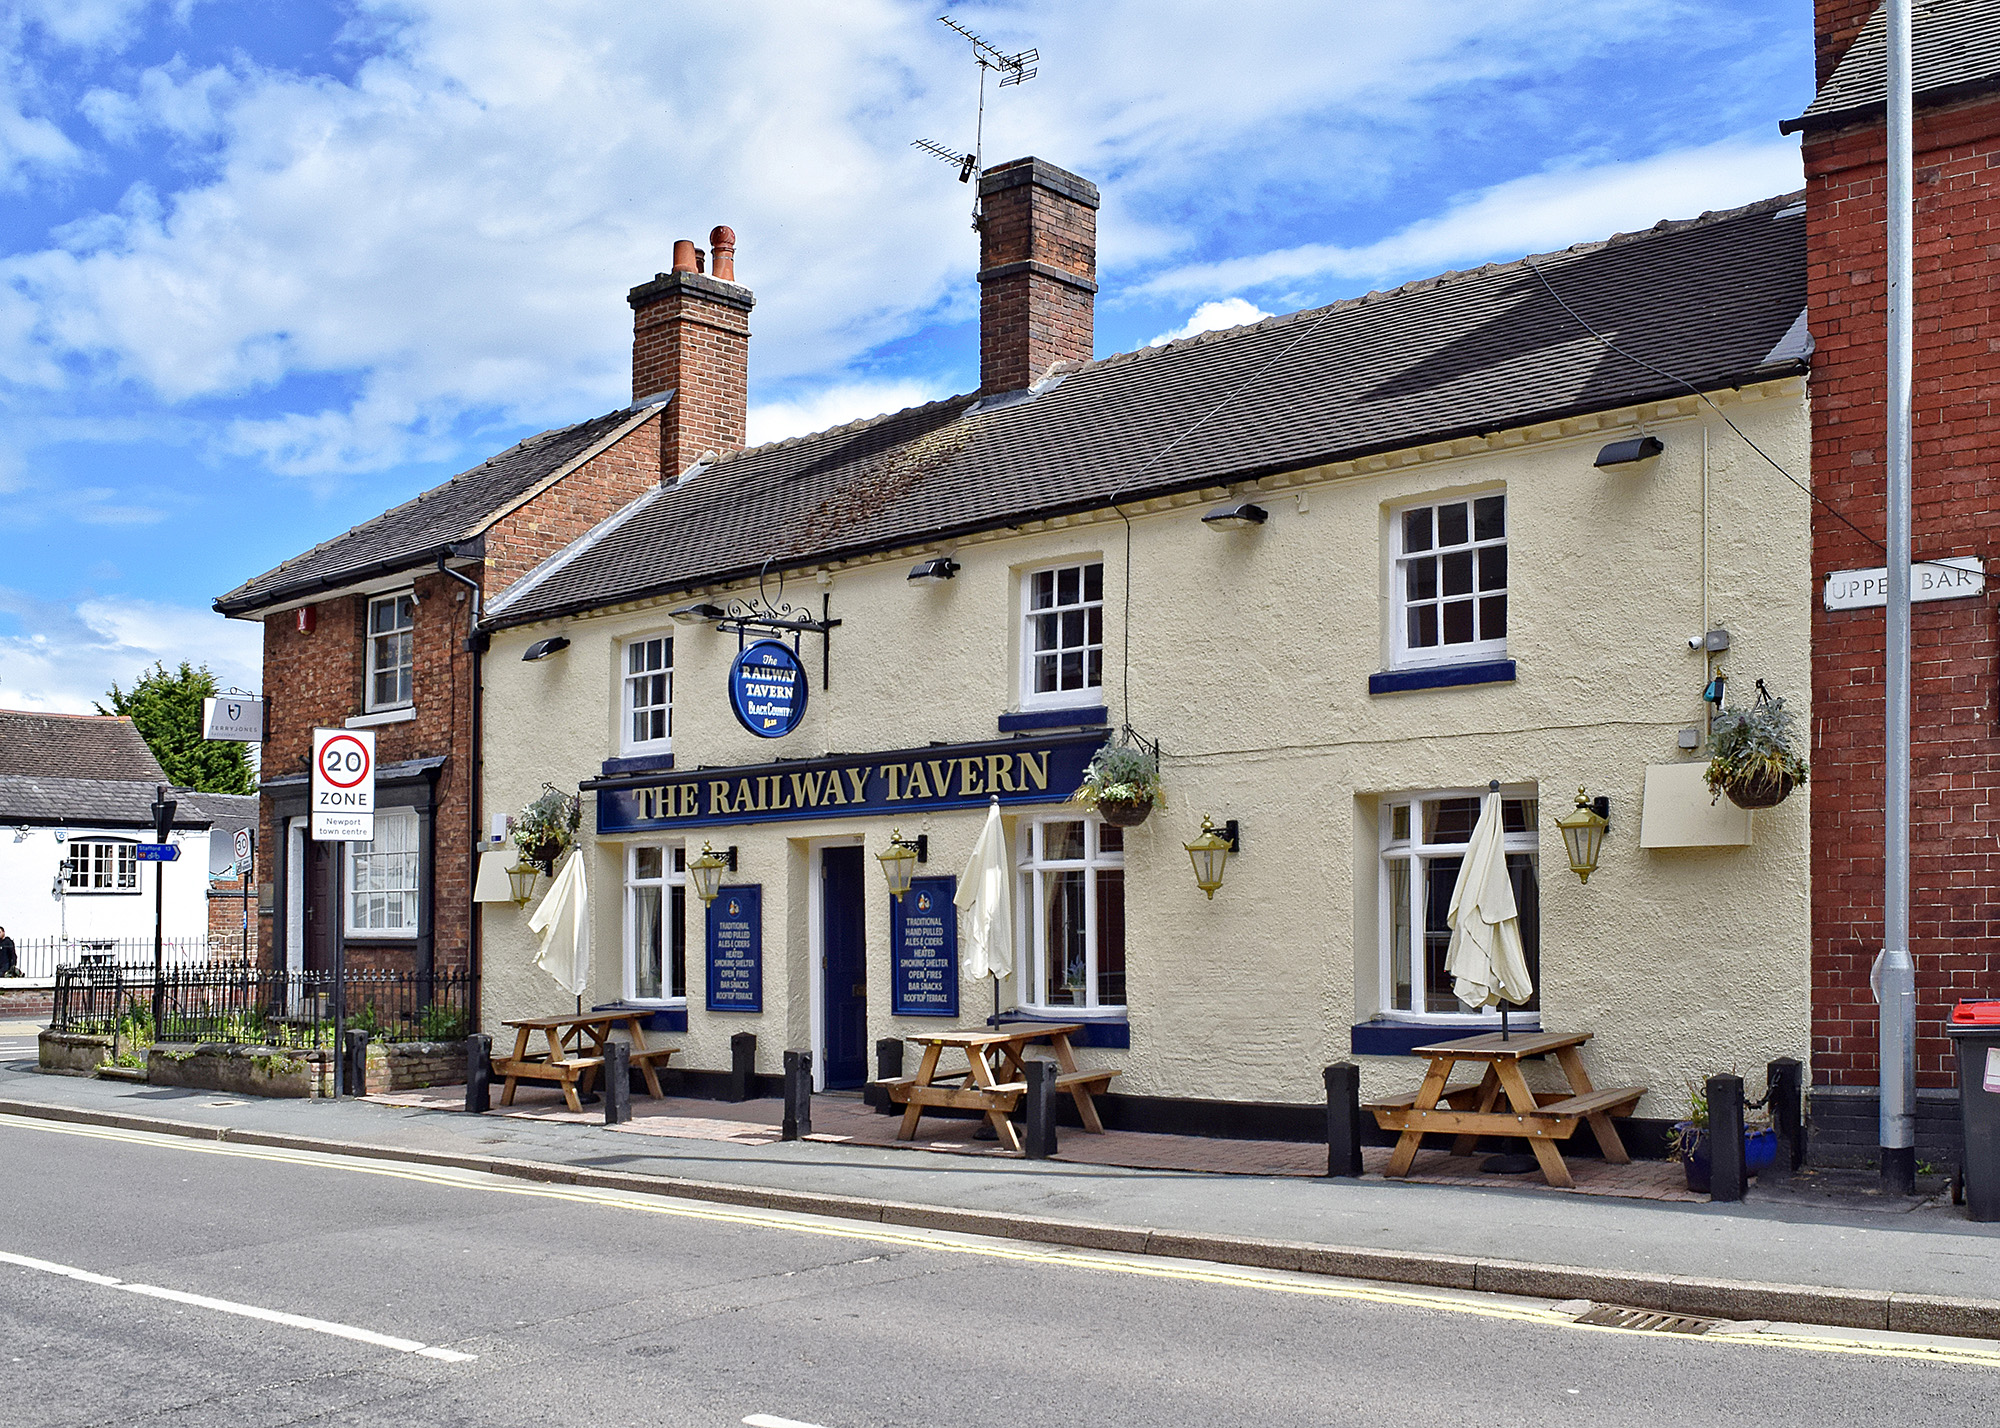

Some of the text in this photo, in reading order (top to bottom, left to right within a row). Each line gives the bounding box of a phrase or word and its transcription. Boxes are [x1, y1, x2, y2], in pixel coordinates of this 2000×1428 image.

[1832, 569, 1973, 599] UPPE BAR
[762, 654, 778, 666] The
[741, 666, 797, 683] RAILWAY
[745, 683, 794, 699] TAVERN
[326, 750, 362, 772] 20
[632, 750, 1051, 820] THE RAILWAY TAVERN
[320, 791, 367, 806] ZONE
[326, 818, 361, 827] Newport
[341, 828, 368, 836] centre
[237, 838, 247, 851] 30
[719, 922, 749, 930] TRADITIONAL
[906, 918, 942, 926] TRADITIONAL
[718, 931, 750, 939] HAND PULLED
[905, 927, 943, 936] HAND PULLED
[718, 940, 730, 948] ALES
[734, 940, 750, 948] CIDERS
[905, 937, 920, 946] ALES
[924, 937, 943, 946] CIDERS
[725, 950, 744, 958] HEATED
[914, 949, 935, 958] HEATED
[714, 959, 755, 967] SMOKING SHELTER
[900, 959, 948, 967] SMOKING SHELTER
[721, 970, 749, 978] OPEN FIRES
[908, 970, 942, 979] OPEN FIRES
[720, 981, 749, 989] BAR SNACKS
[908, 982, 943, 991] BAR SNACKS
[716, 992, 753, 1000] ROOFTOP TERRACE
[903, 994, 947, 1003] ROOFTOP TERRACE
